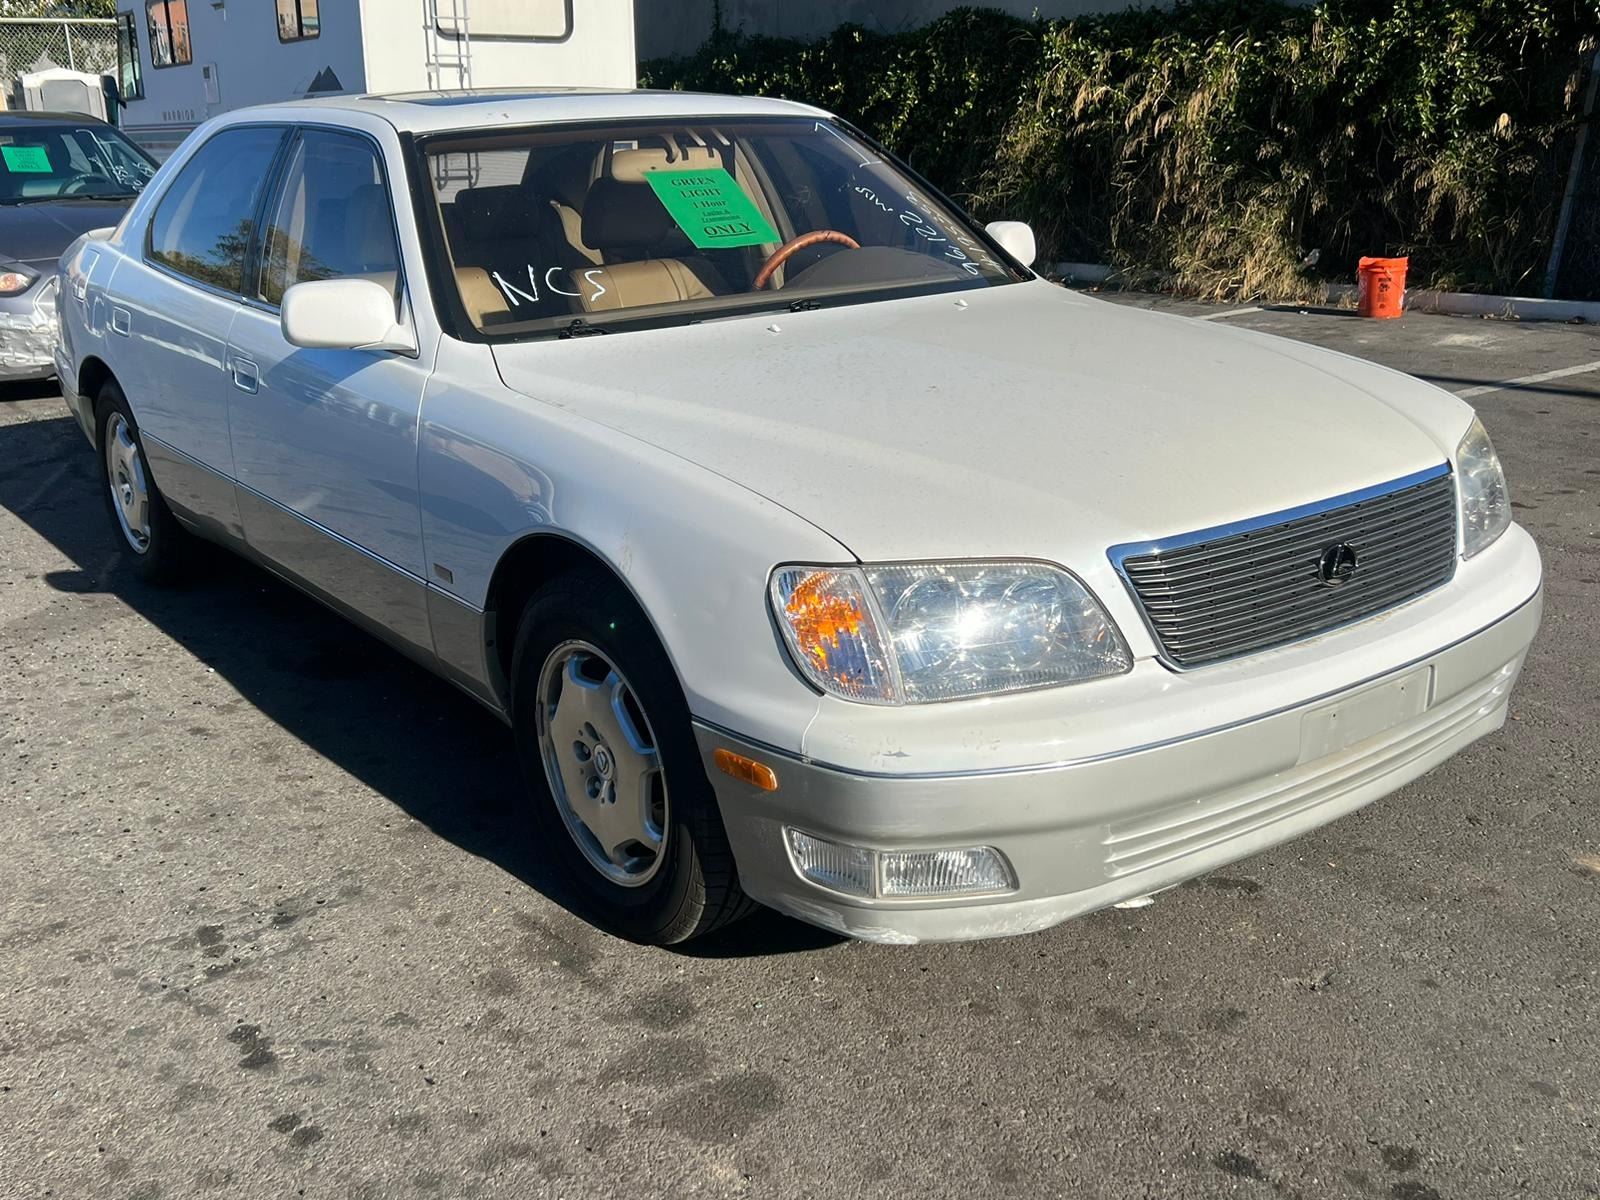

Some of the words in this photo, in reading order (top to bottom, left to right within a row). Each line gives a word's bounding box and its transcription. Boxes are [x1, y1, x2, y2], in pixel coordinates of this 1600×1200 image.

[671, 177, 716, 186] GREEN
[680, 188, 721, 198] LIGHT
[693, 201, 699, 209] 1
[700, 200, 727, 208] Hour
[703, 222, 752, 236] ONLY
[492, 264, 606, 306] NCS
